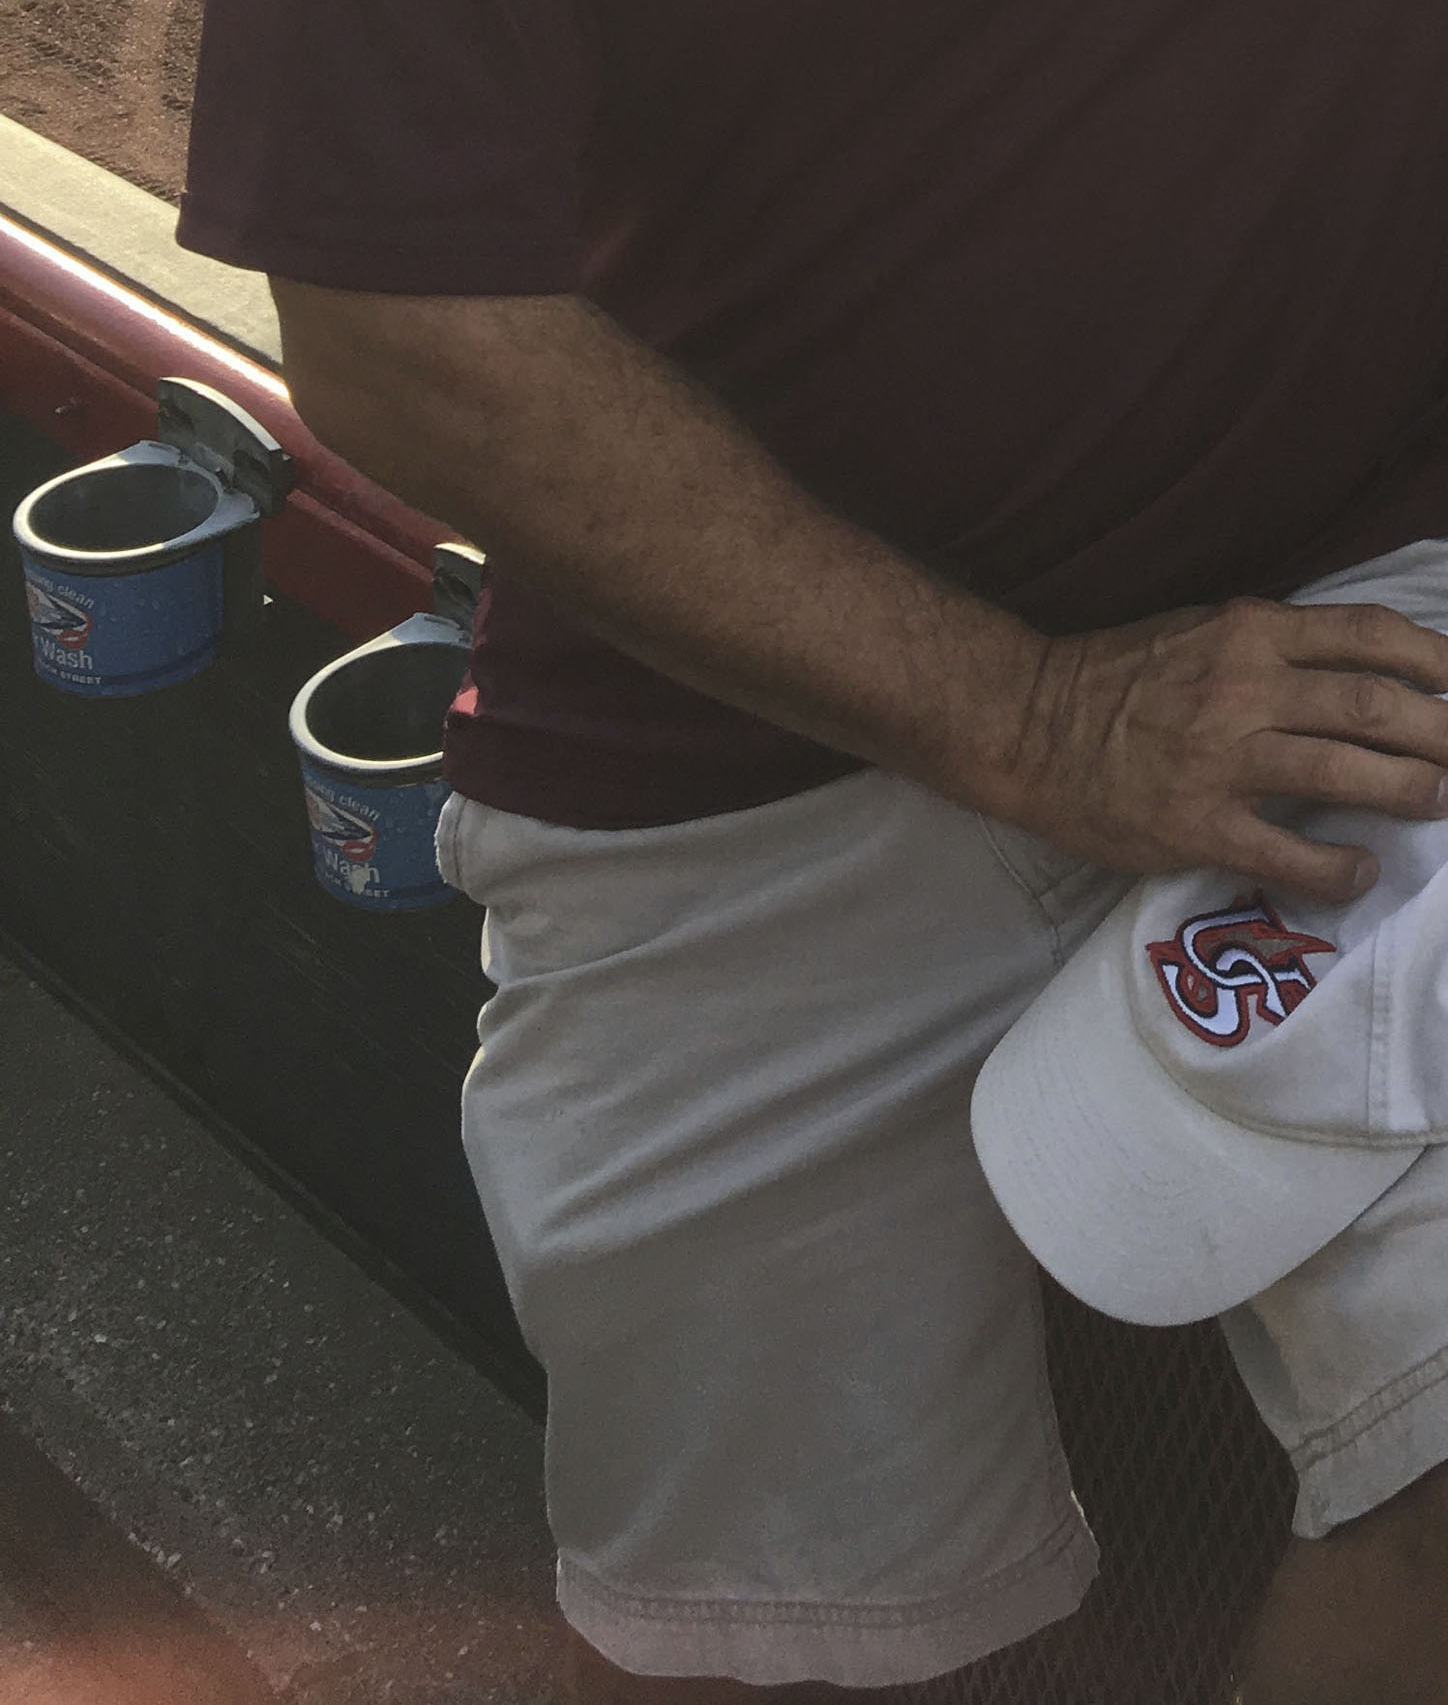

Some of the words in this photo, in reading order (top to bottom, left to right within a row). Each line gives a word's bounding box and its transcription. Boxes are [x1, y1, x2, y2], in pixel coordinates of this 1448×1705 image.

[57, 584, 95, 609] clean
[41, 635, 94, 670] Wash
[60, 671, 102, 685] STREET
[340, 795, 380, 821] clean
